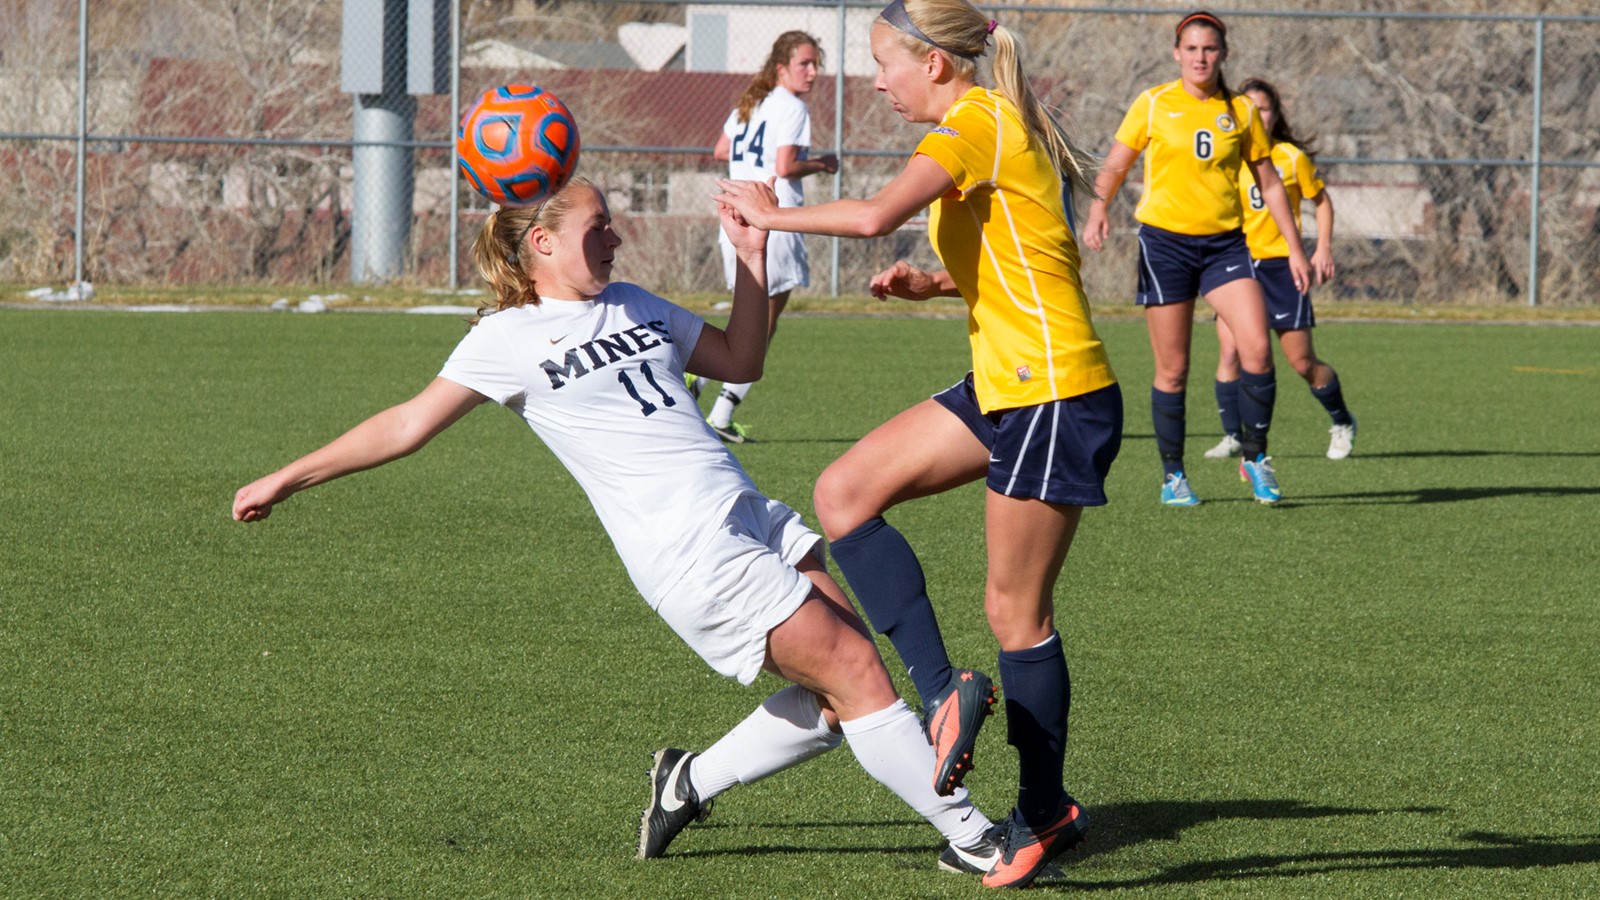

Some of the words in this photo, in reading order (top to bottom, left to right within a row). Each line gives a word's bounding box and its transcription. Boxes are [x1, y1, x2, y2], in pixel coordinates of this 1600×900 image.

[732, 119, 766, 168] 24
[1195, 129, 1213, 160] 6
[1250, 184, 1265, 210] 9
[538, 319, 674, 390] MINES
[617, 360, 676, 417] 11
